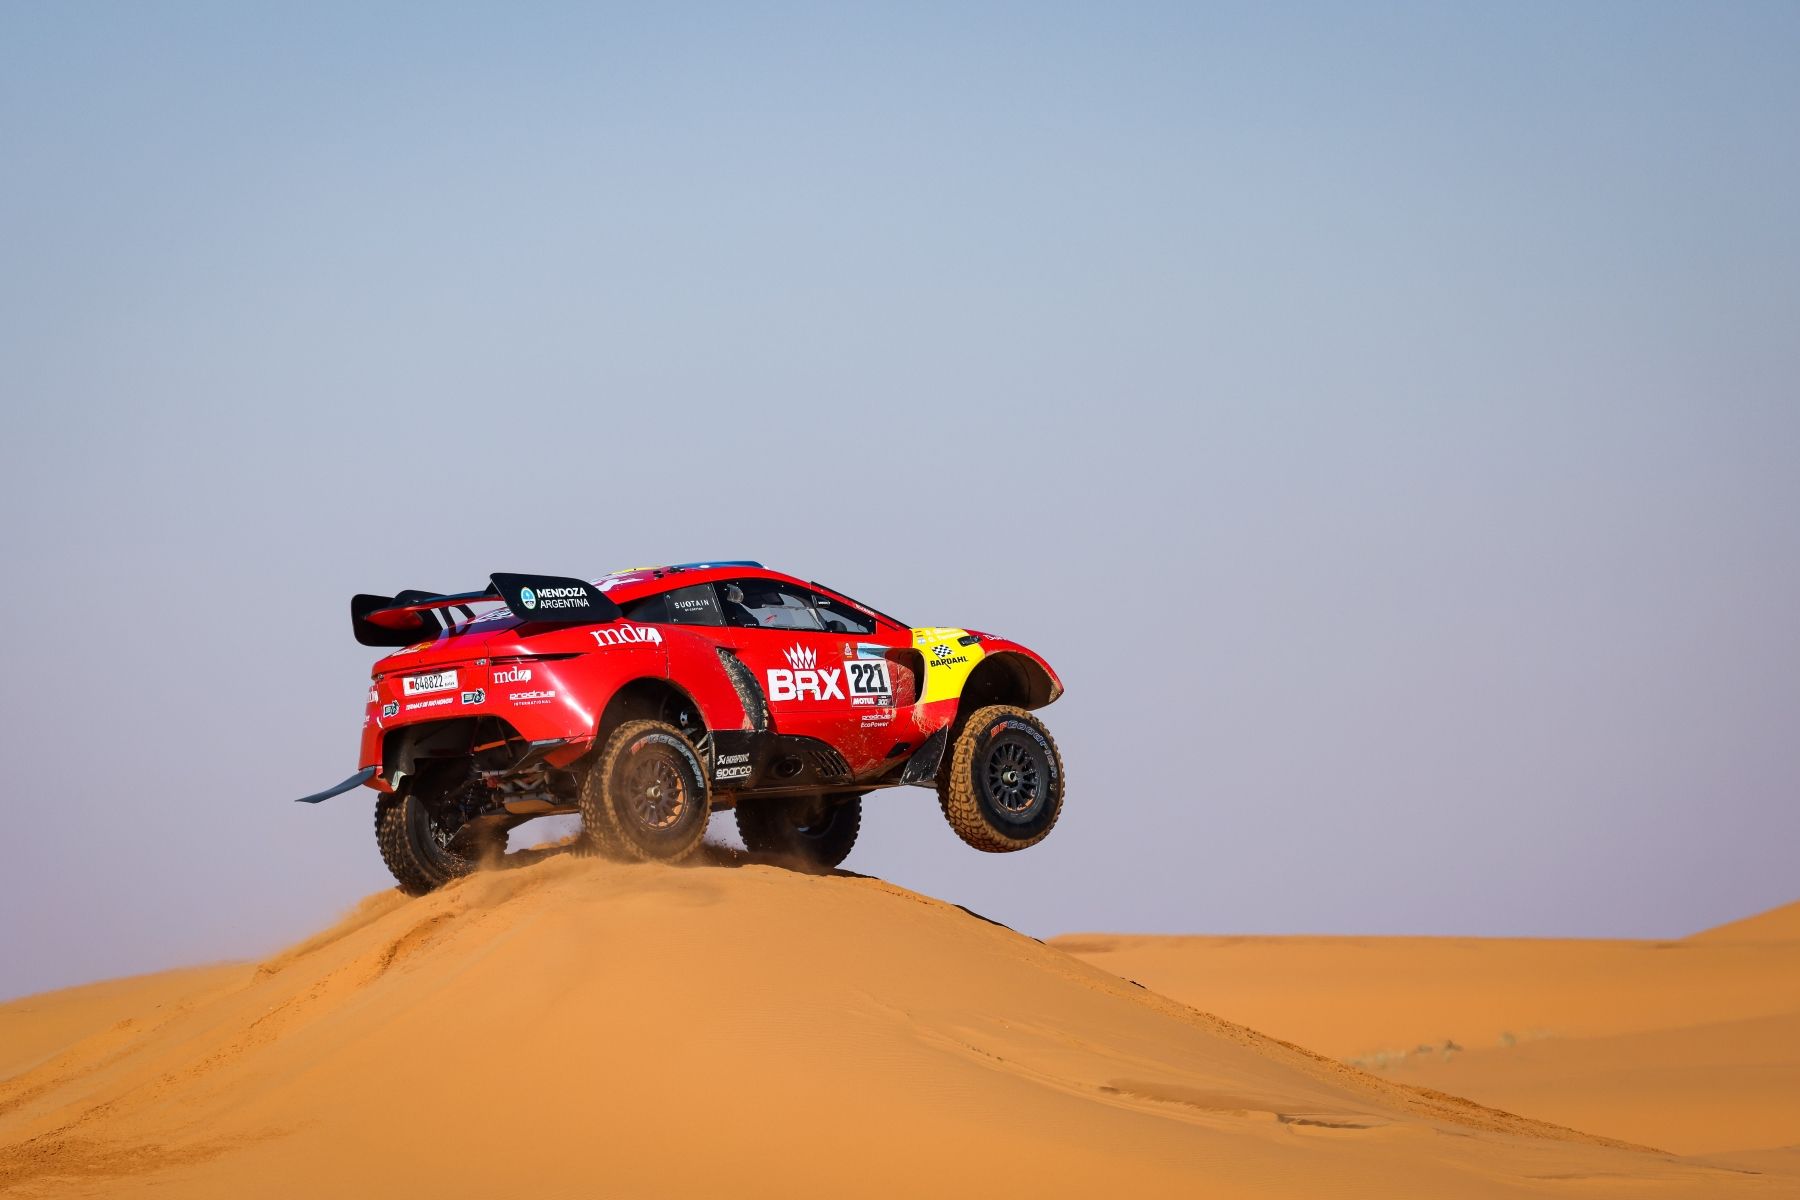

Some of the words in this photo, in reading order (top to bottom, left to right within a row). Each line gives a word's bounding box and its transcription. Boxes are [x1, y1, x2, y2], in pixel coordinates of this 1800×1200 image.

[536, 587, 587, 599] MENDOZA
[539, 598, 590, 609] ARGENTINA
[930, 656, 969, 668] BARDAHL
[493, 666, 532, 684] mdz
[850, 663, 888, 694] 221
[415, 674, 444, 691] 648822
[767, 668, 846, 702] BRX
[853, 697, 875, 706] MOTUL
[860, 721, 889, 729] EcoPower
[715, 765, 752, 780] sparco
